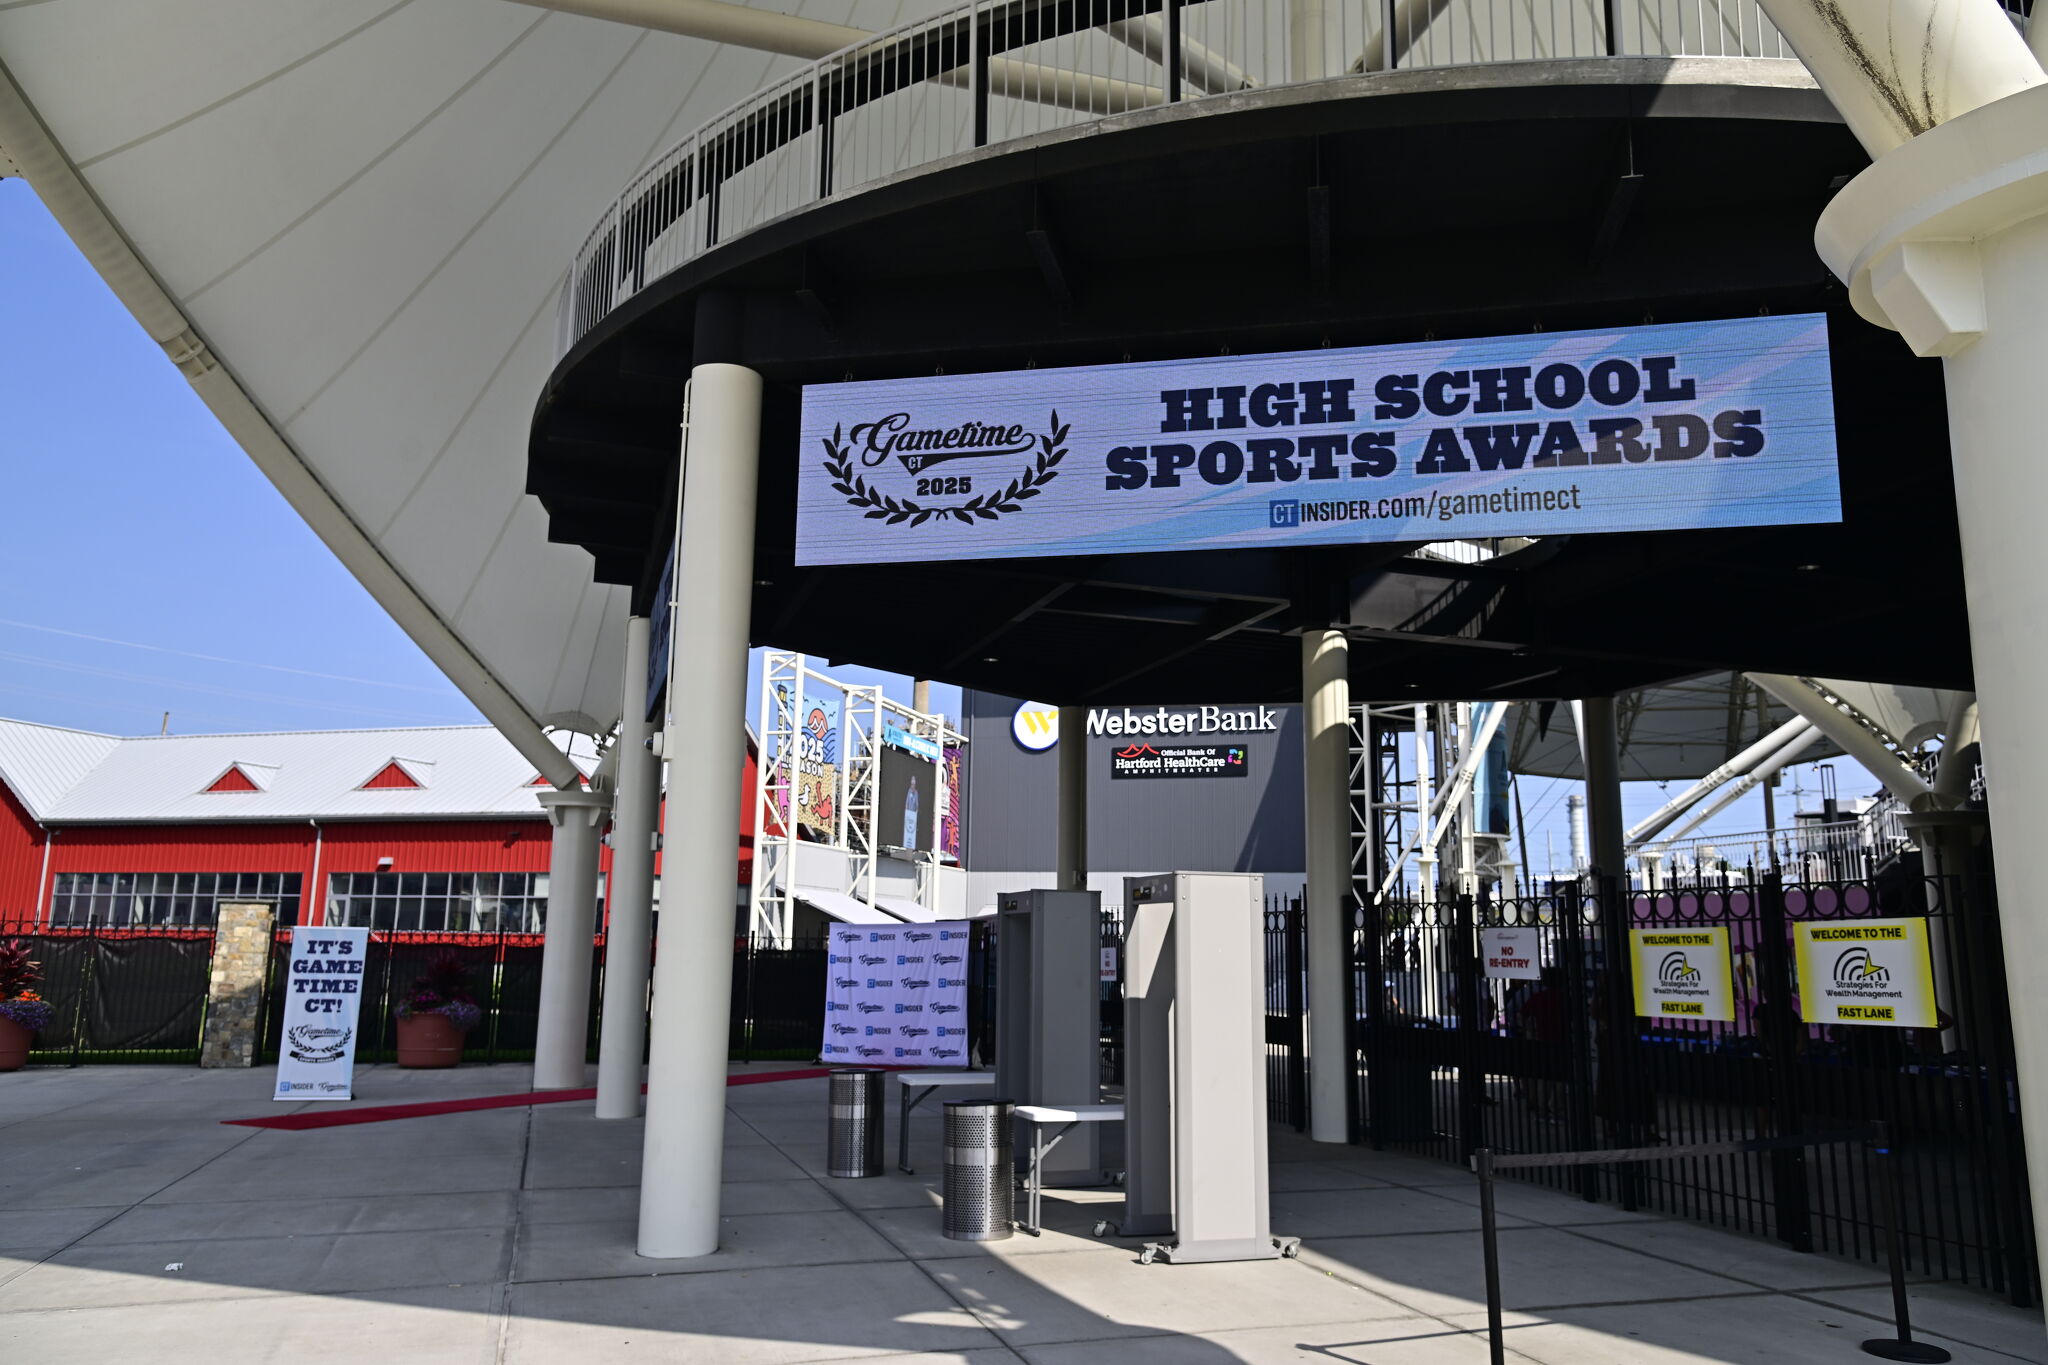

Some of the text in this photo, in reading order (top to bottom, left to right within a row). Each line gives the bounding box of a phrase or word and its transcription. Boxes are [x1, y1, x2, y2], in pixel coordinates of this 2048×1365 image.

[1160, 355, 1697, 433] HIGH SCHOOL
[850, 412, 1036, 467] Gametime
[1105, 409, 1766, 491] SPORTS AWARDS
[907, 455, 924, 469] CT
[916, 477, 972, 496] 2025
[1116, 757, 1226, 769] Hartford HealthCare
[1642, 935, 1710, 944] WELCOME TO THE
[1810, 928, 1902, 939] WELCOME TO THE
[307, 940, 353, 955] IT'S
[1501, 946, 1514, 956] NO
[293, 960, 363, 974] GAME
[1489, 958, 1530, 968] RE-ENTRY
[294, 979, 358, 993] TIME
[1660, 980, 1688, 988] Strategies
[1835, 981, 1888, 990] Strategies For
[1673, 988, 1710, 996] Management
[1825, 989, 1902, 999] Wealth Management
[305, 999, 342, 1013] CT!
[1661, 1003, 1703, 1013] FAST LANE
[1837, 1007, 1893, 1018] FAST LANE
[296, 1024, 343, 1038] Gametime
